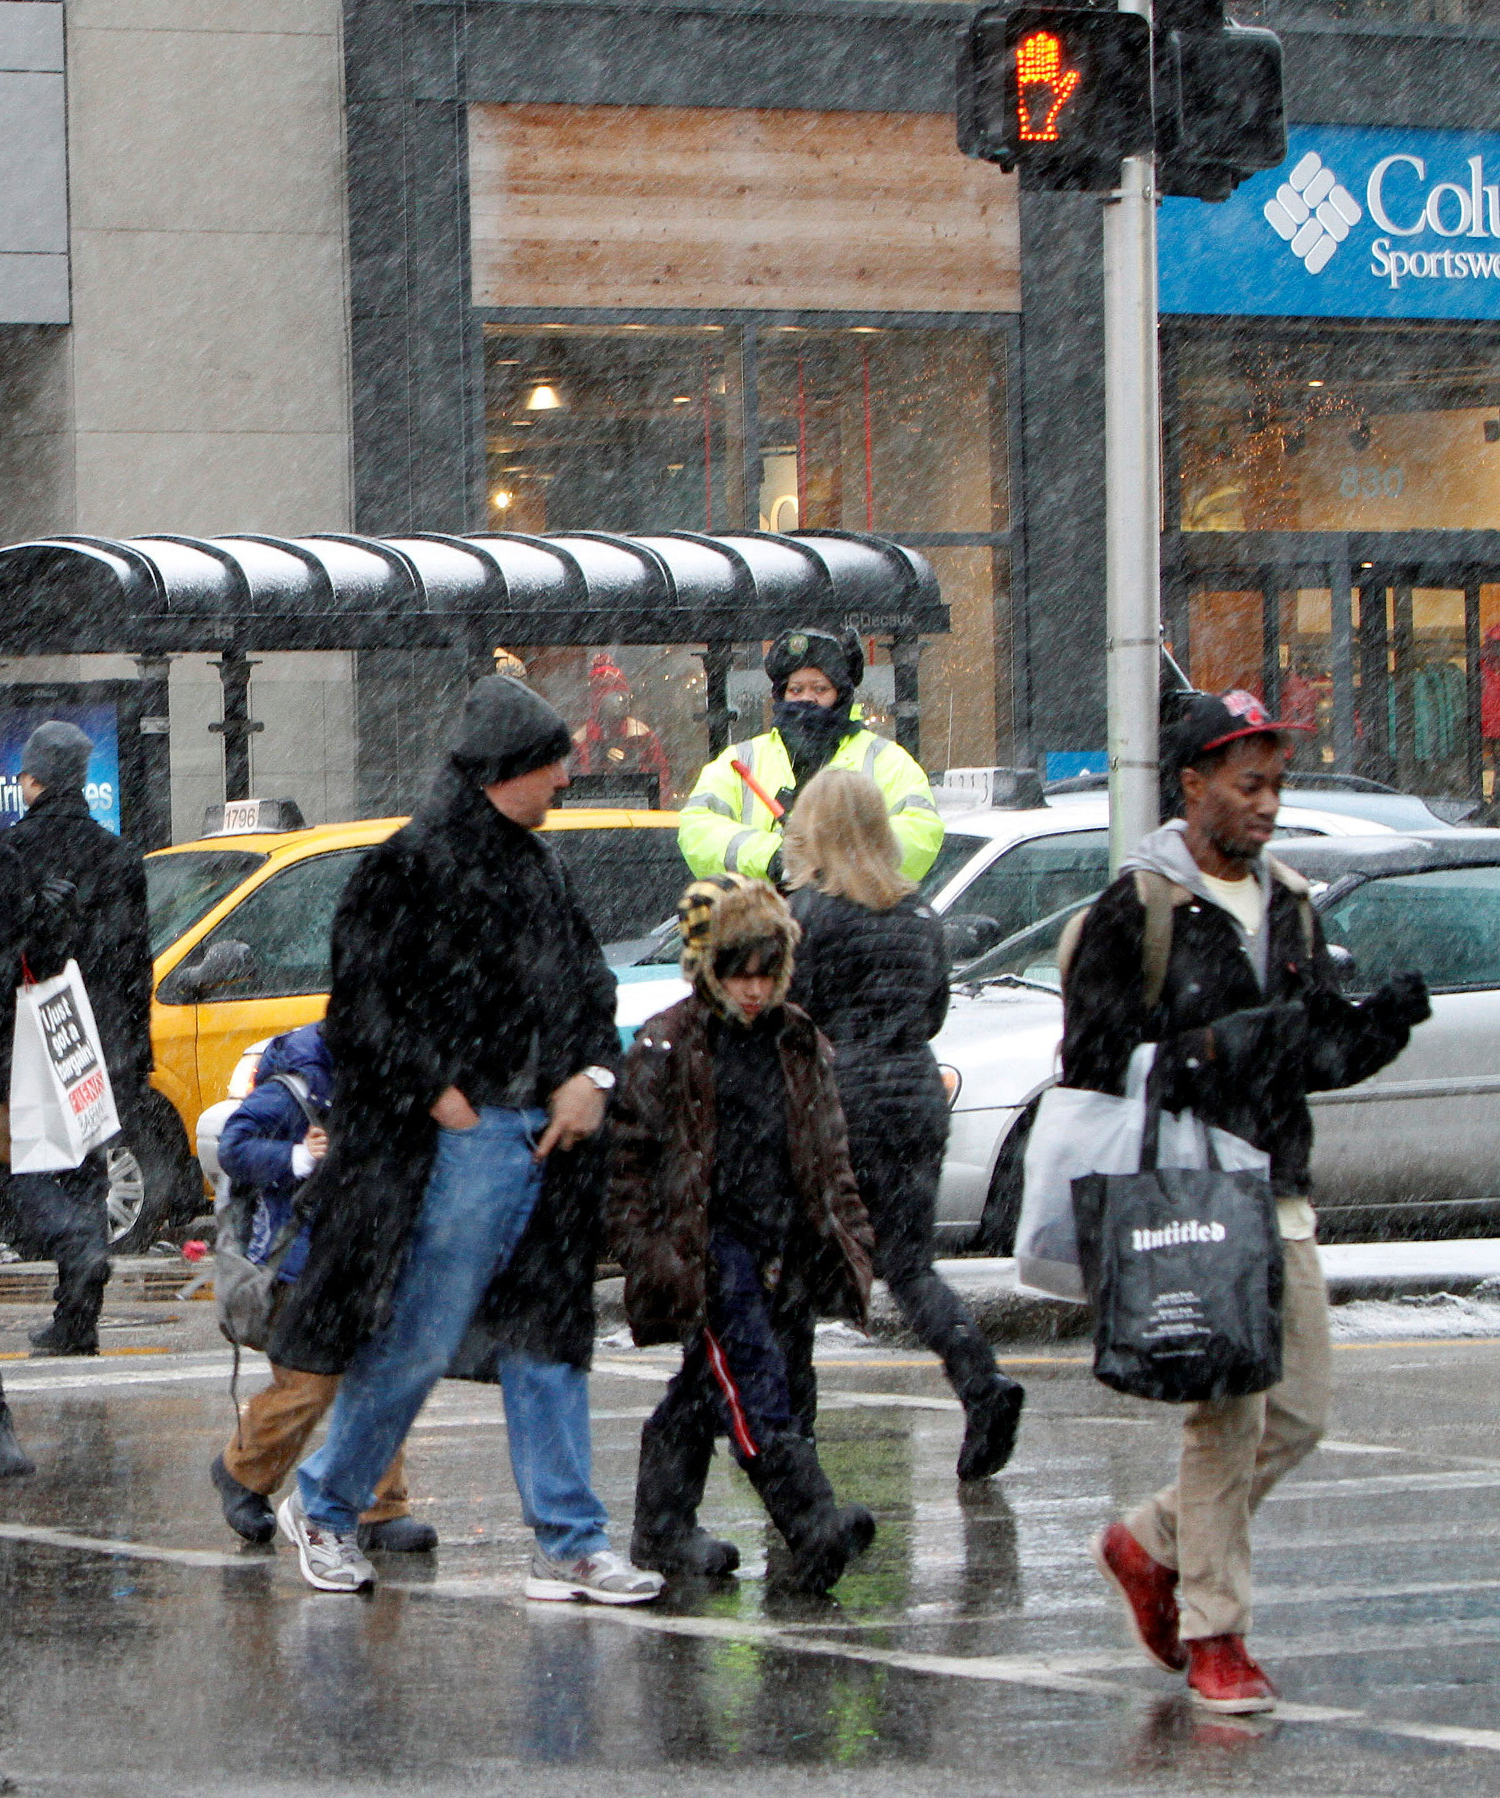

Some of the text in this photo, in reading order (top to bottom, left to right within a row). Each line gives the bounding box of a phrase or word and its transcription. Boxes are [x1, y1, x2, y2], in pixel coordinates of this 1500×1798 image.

[1339, 465, 1405, 499] 830
[225, 807, 257, 830] 1796
[45, 995, 73, 1034] just
[51, 1021, 81, 1058] got a
[54, 1037, 97, 1084] bargain!
[1131, 1219, 1227, 1252] Untitled
